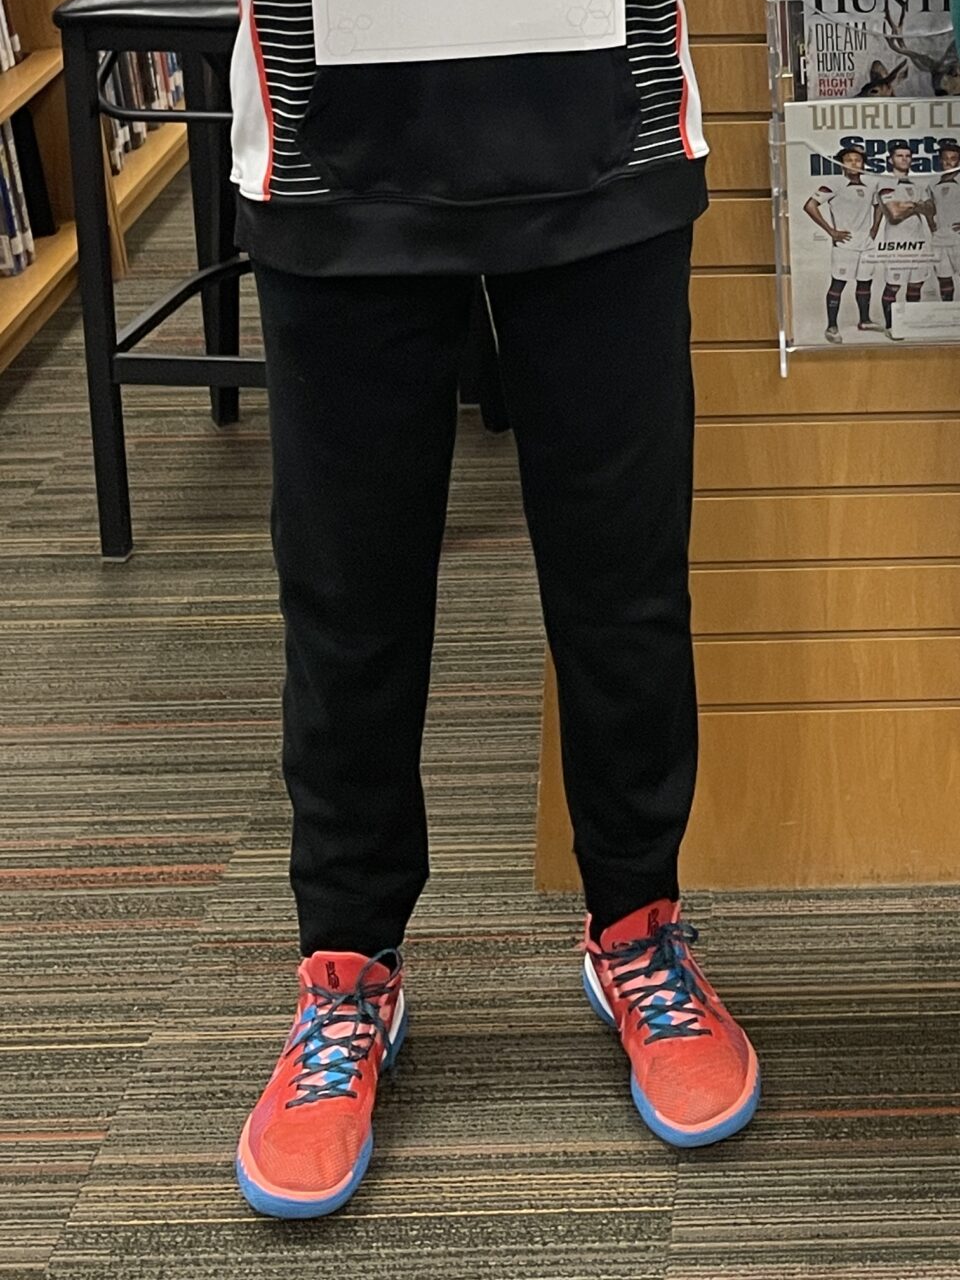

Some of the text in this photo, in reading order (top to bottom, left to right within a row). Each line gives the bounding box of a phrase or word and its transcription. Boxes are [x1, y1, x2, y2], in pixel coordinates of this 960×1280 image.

[815, 21, 867, 52] DREAM
[817, 51, 855, 72] HUNTS
[819, 77, 854, 88] RIGHT
[819, 88, 848, 97] NOW!
[808, 103, 916, 131] WORLD
[878, 241, 926, 252] USMNT
